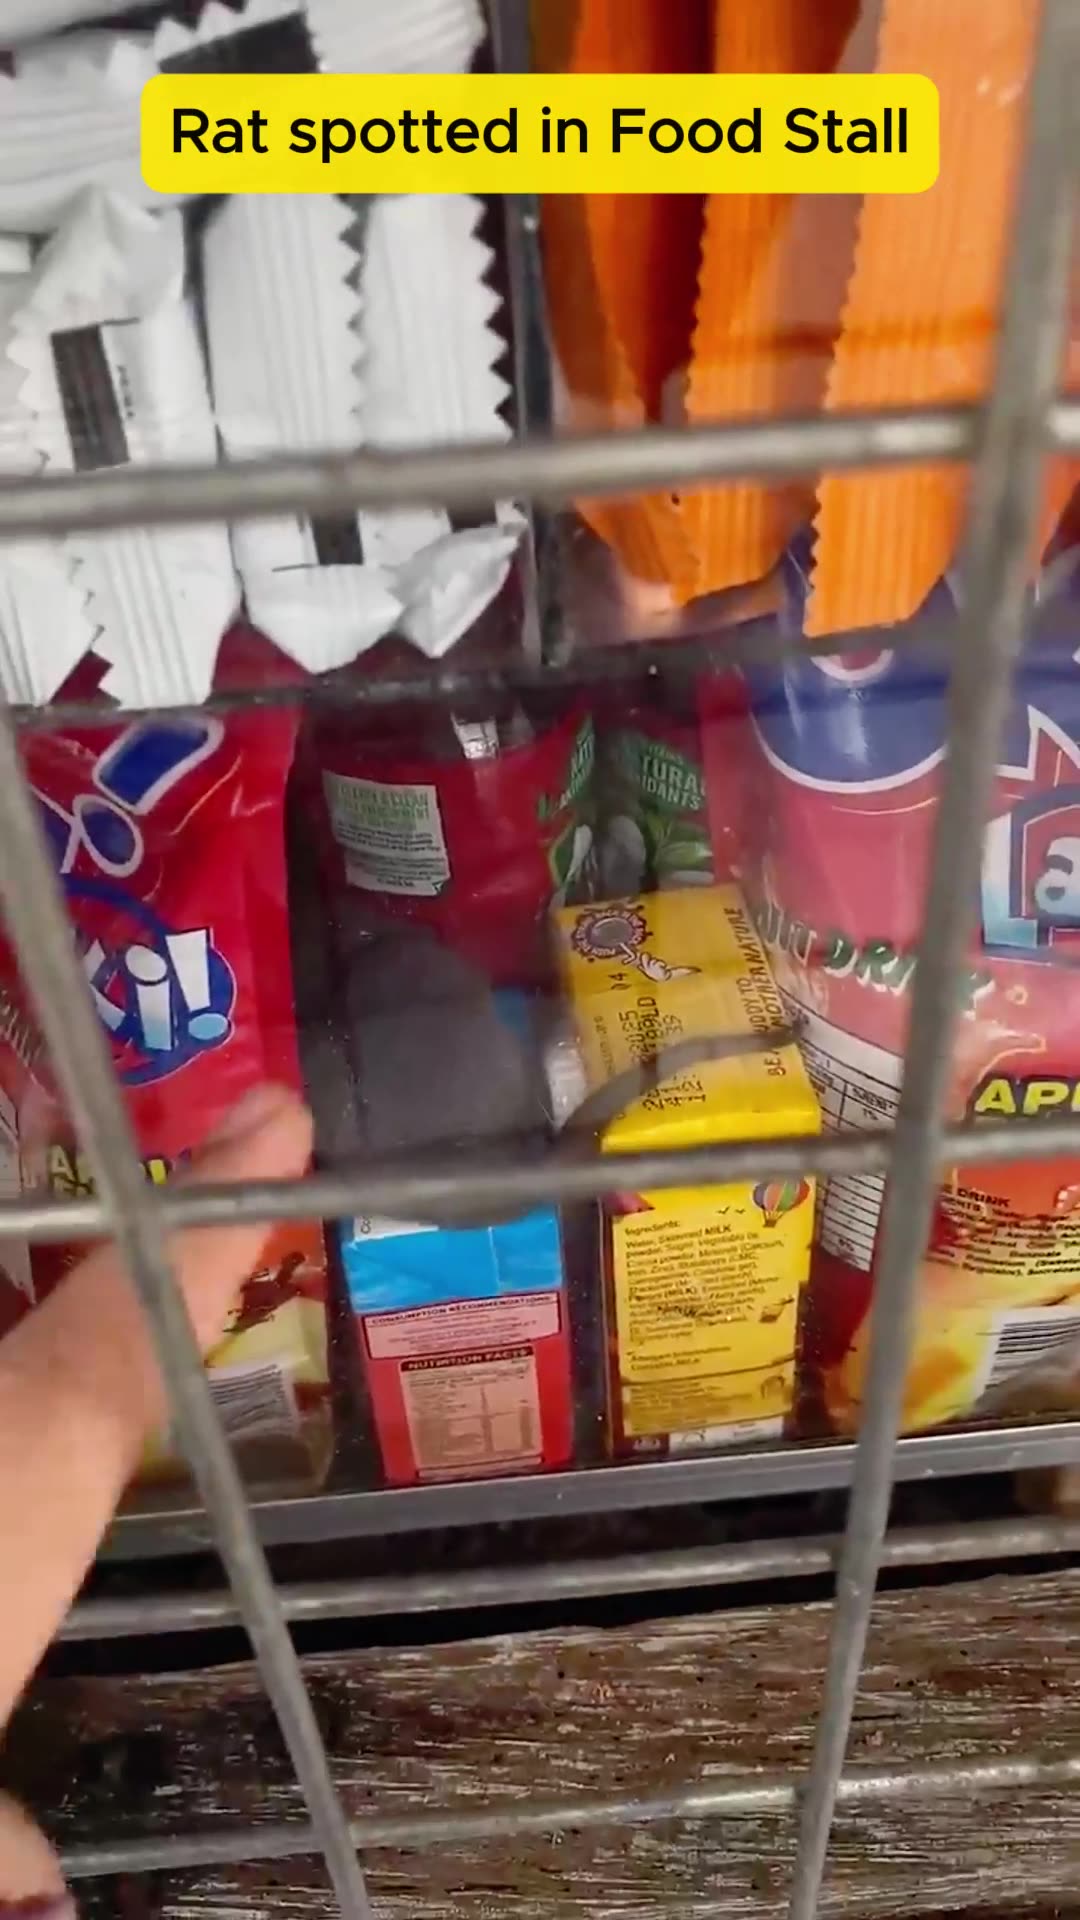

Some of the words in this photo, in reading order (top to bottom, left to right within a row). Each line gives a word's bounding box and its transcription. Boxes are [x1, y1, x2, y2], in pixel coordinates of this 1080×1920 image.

[641, 775, 702, 811] IDANTS
[642, 755, 706, 796] TURA
[723, 907, 765, 966] NATURE
[748, 966, 791, 1030] MOTHER
[973, 1078, 1080, 1115] AP
[957, 1187, 1011, 1208] DRINK
[704, 1224, 732, 1236] MILK
[371, 1308, 448, 1326] CONSUMPTION
[407, 1353, 483, 1371] NUTRITION
[484, 1348, 529, 1362] FACTS
